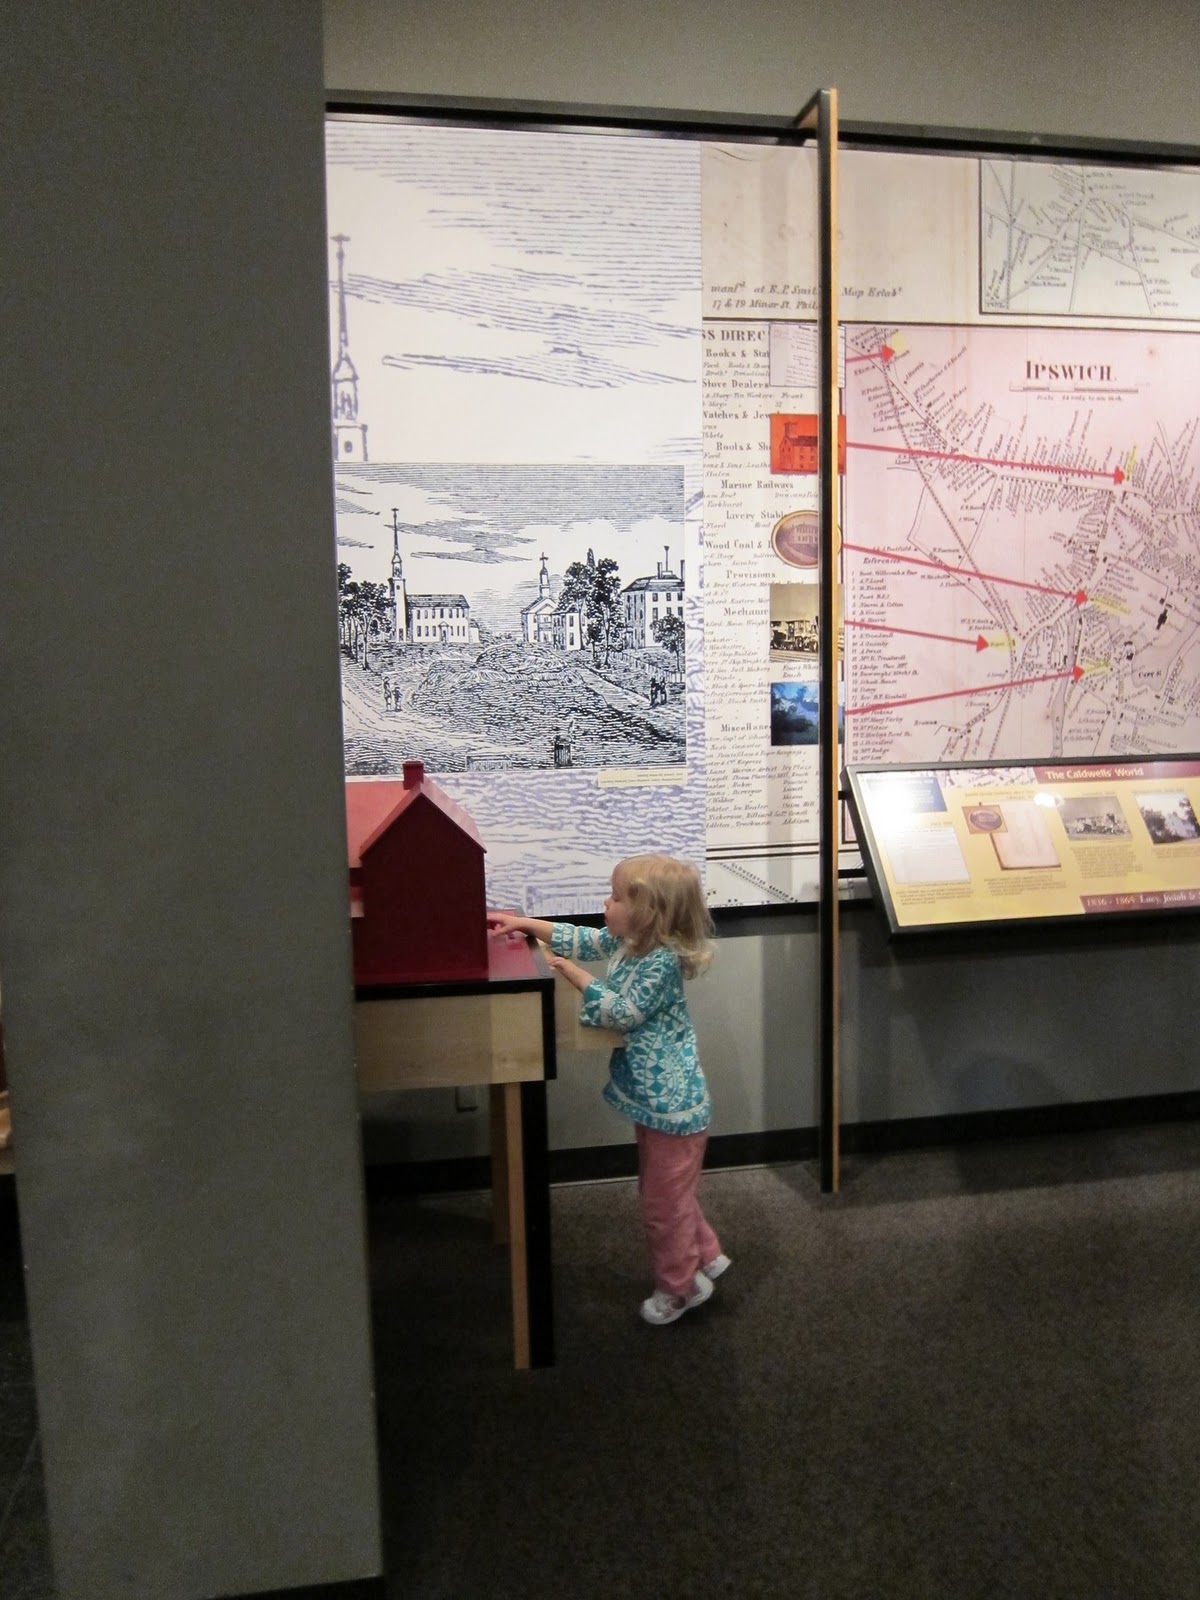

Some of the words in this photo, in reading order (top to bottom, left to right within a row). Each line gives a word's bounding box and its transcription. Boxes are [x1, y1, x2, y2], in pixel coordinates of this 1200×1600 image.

[791, 285, 819, 295] Smit
[840, 287, 865, 299] Map
[724, 299, 732, 308] &
[735, 299, 746, 308] 19
[796, 301, 819, 310] Phil
[721, 329, 770, 342] DIREC
[706, 349, 737, 358] Books
[740, 349, 748, 358] &
[703, 379, 728, 389] Stove
[731, 379, 770, 389] Dealers
[742, 410, 749, 420] &
[717, 441, 744, 451] Boots
[745, 442, 752, 451] &
[758, 441, 771, 451] Sho
[721, 480, 753, 490] Marine
[756, 480, 794, 490] Railways
[726, 510, 756, 522] Livery
[760, 511, 788, 520] Stabl
[706, 539, 731, 550] Wood
[733, 540, 754, 549] Coal
[757, 540, 763, 549] &
[726, 569, 777, 580] Provisions
[723, 607, 769, 617] Mechanic
[720, 723, 770, 733] Miscellane
[1045, 770, 1065, 781] The
[1114, 766, 1145, 778] World
